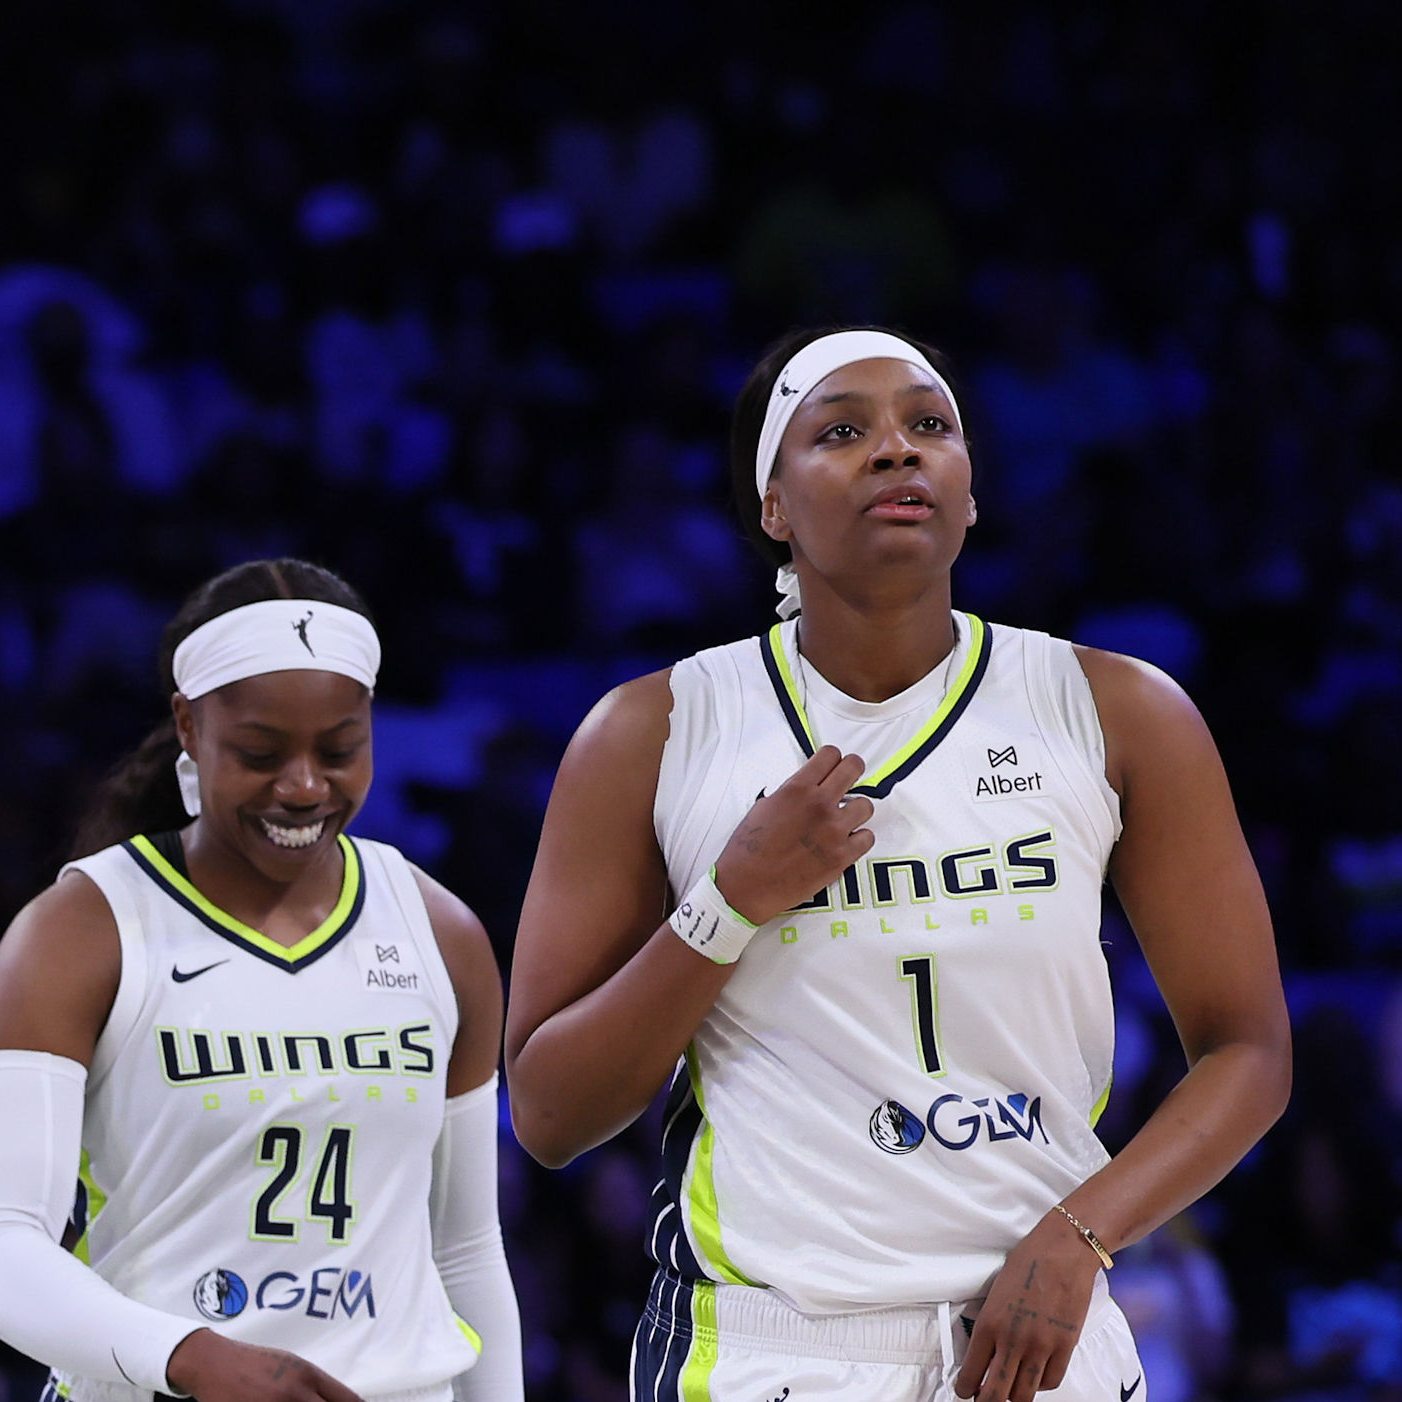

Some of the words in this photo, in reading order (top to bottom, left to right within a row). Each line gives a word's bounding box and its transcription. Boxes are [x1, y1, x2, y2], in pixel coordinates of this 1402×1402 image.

[975, 772, 1043, 797] Albert
[775, 826, 1060, 917] INGS
[780, 904, 1035, 945] DALLAS
[366, 970, 418, 991] Albert
[897, 953, 947, 1077] 1
[154, 1019, 436, 1087] WINGS
[203, 1085, 418, 1110] DALLAS
[249, 1121, 357, 1246] 24
[256, 1267, 376, 1320] GEM
